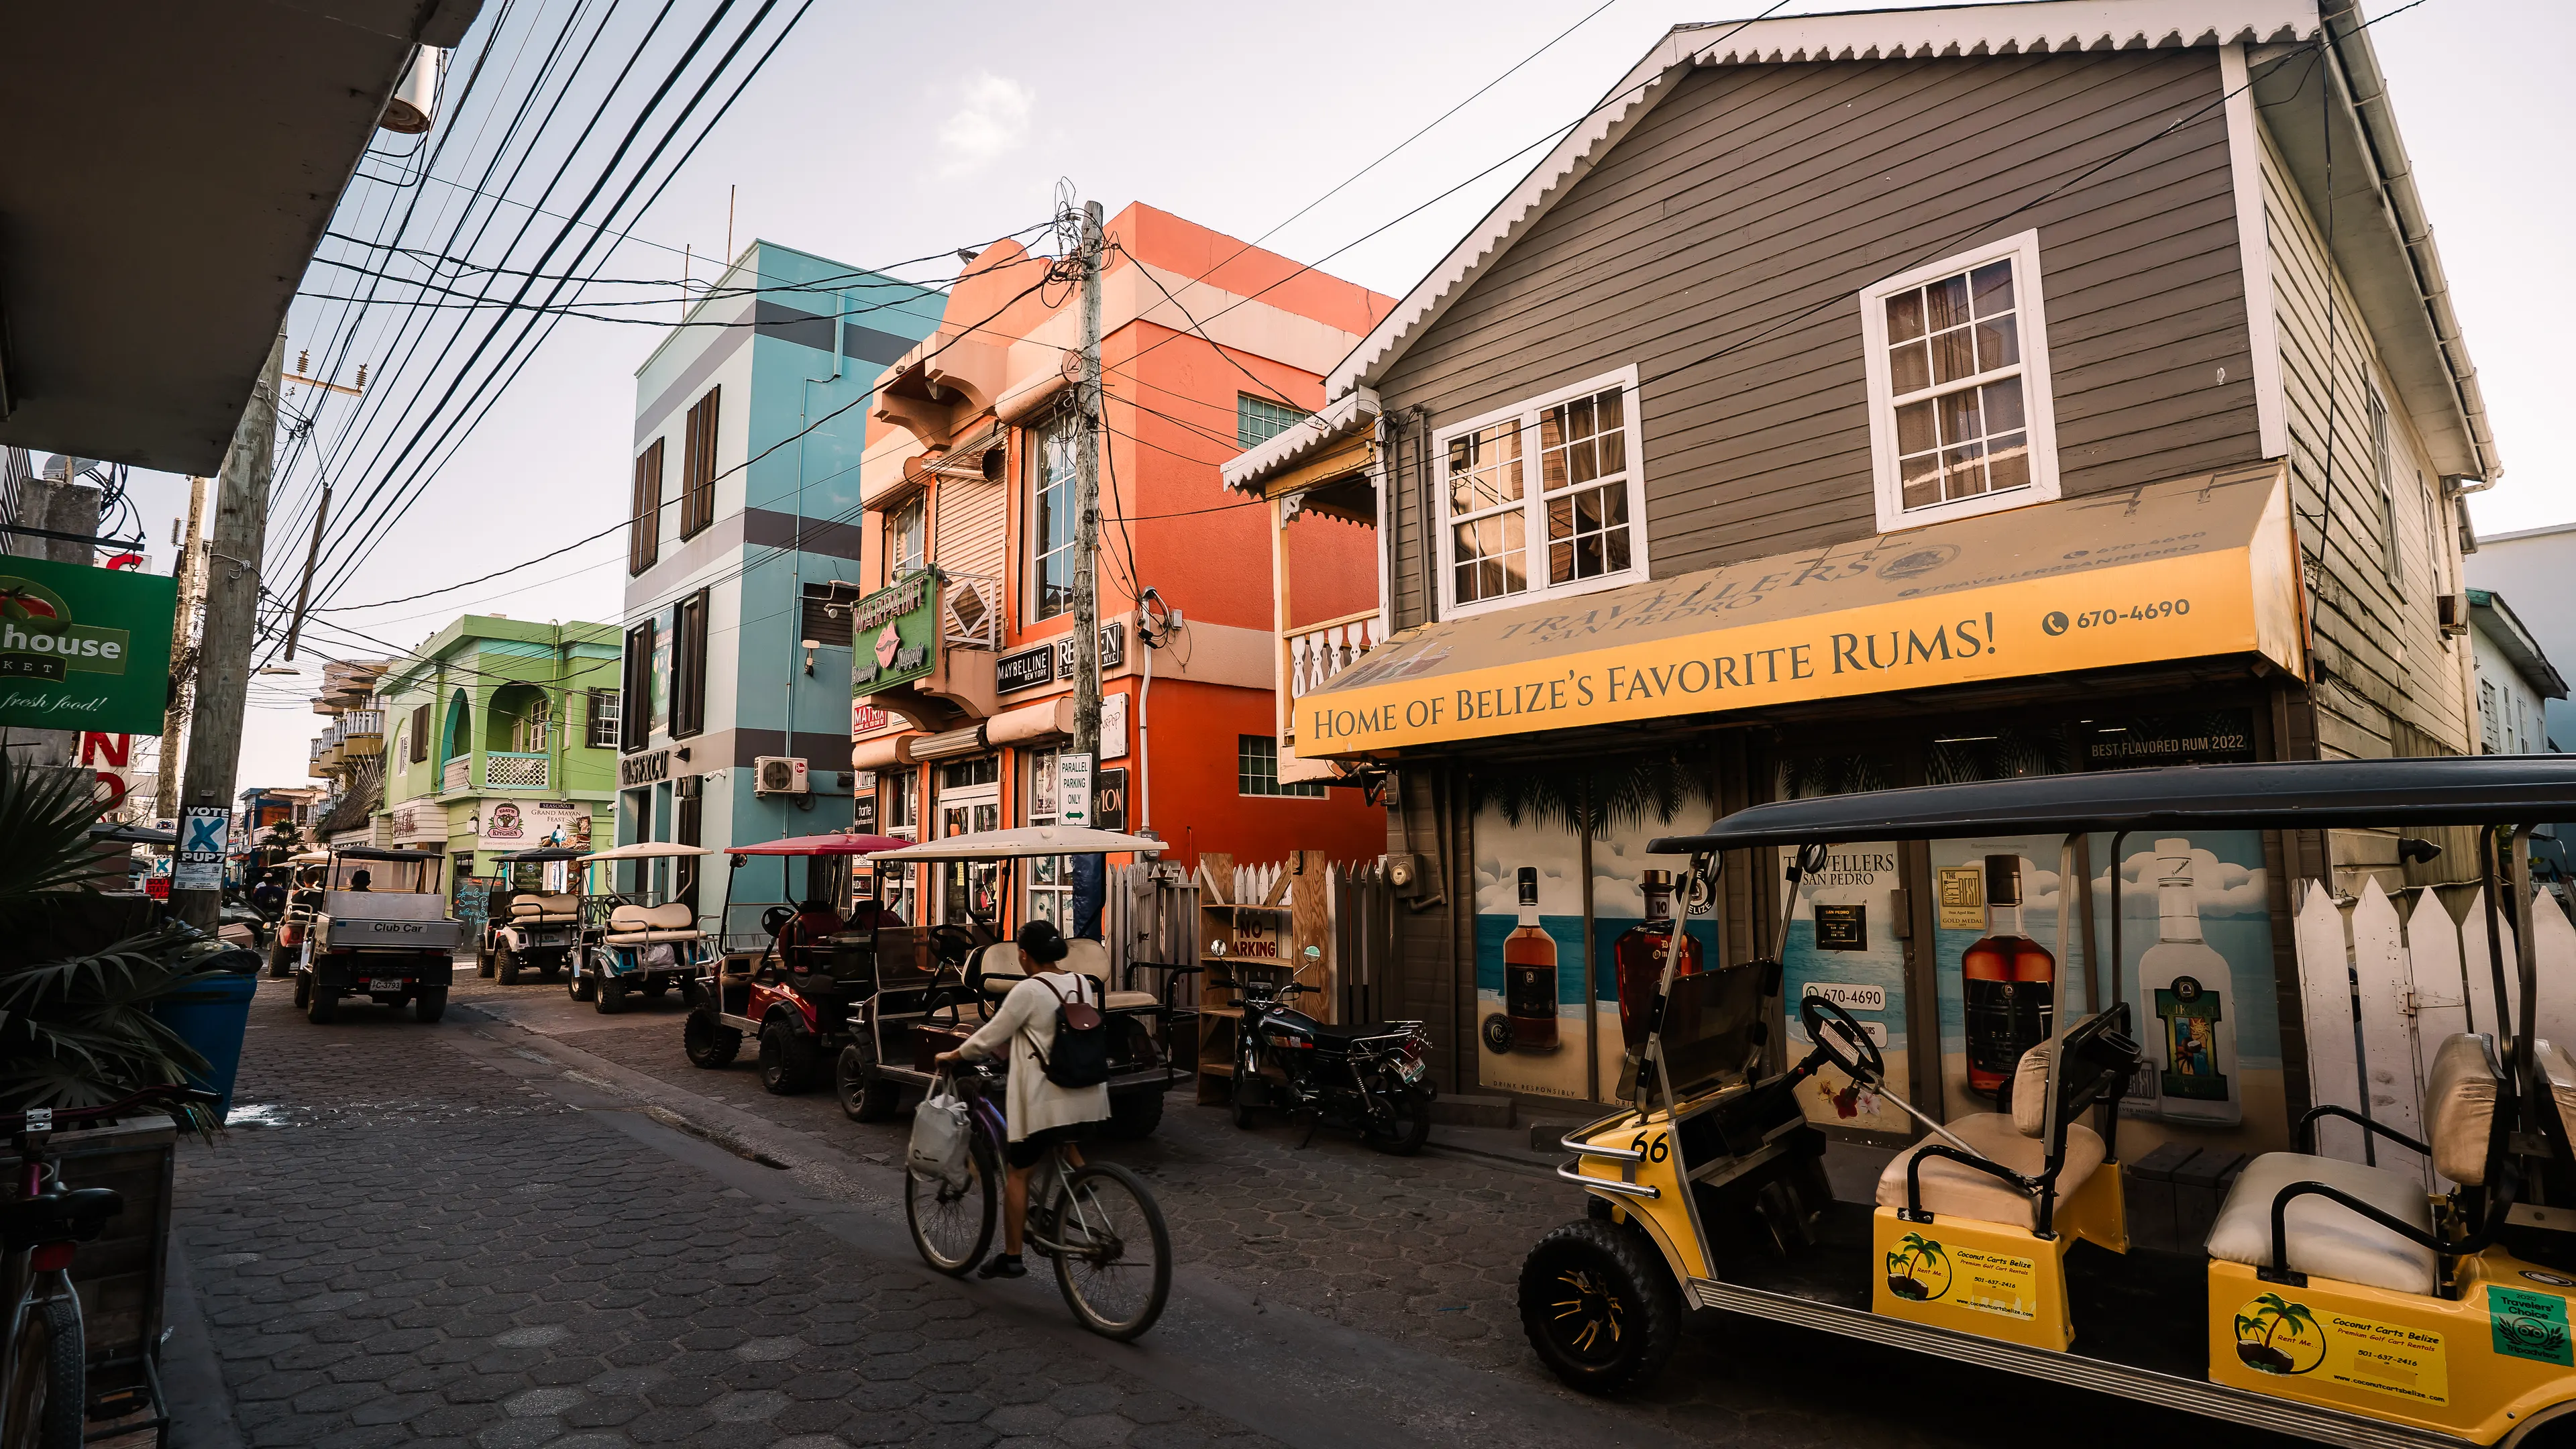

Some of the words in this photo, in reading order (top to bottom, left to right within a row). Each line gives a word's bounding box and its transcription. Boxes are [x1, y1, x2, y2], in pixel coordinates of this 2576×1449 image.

[2096, 531, 2207, 554] 670-4690
[854, 576, 924, 634] WARPAINT
[1495, 555, 1879, 640] TRAVELLERS
[1529, 623, 1607, 646] SAN
[1611, 595, 1763, 630] PEDRO
[2077, 598, 2190, 629] 670-4690
[851, 661, 877, 686] Beauty
[895, 641, 924, 672] Supply
[1104, 652, 1116, 663] NYC
[998, 653, 1046, 681] MAYBELLINE
[1024, 672, 1034, 681] NEW
[1034, 668, 1046, 679] YORK
[1313, 704, 1397, 740] HOME
[1405, 696, 1444, 728] OF
[1456, 669, 1594, 722] BELIZE'S
[1607, 644, 1814, 703] FAVORITE
[1830, 611, 1996, 676] RUMS!
[0, 692, 48, 709] fresh
[42, 695, 108, 713] food!
[2092, 744, 2118, 757] BEST
[2123, 739, 2178, 755] FLAVORED
[2182, 737, 2208, 751] RUM
[2212, 735, 2244, 749] 2022
[1062, 762, 1087, 772] PARALLEL
[675, 775, 696, 797] ATM
[1063, 778, 1085, 789] PARKING
[1067, 794, 1081, 804] ONLY
[187, 807, 229, 817] VOTE
[859, 804, 871, 816] tarte
[1783, 853, 1894, 873] TVELLERS
[1803, 874, 1826, 885] SAN
[1831, 873, 1874, 885] PEDRO
[1958, 877, 1978, 906] BEST
[1656, 901, 1667, 914] 10
[1688, 901, 1711, 914] ELIZE
[374, 923, 400, 932] Club
[403, 924, 423, 932] Car
[1240, 920, 1263, 938] NO
[1233, 941, 1276, 957] ARKING
[1823, 989, 1880, 1005] 670-4690
[1493, 1081, 1517, 1089] DRINK
[1521, 1084, 1575, 1097] RESPONSIBLY
[1631, 1130, 1668, 1163] 66
[1957, 1251, 1984, 1261] Coconut
[1987, 1255, 2006, 1265] Carts
[2010, 1259, 2031, 1269] Belize
[1960, 1259, 1982, 1268] Premium
[2008, 1268, 2029, 1276] Rentals
[1917, 1267, 1931, 1275] Rent
[1974, 1276, 2016, 1289] 501-637-2416
[1956, 1299, 2034, 1318] www.coconutcartsbelize.com
[2332, 1317, 2372, 1332] Coconut
[2375, 1324, 2404, 1338] Carts
[2408, 1330, 2440, 1345] Belize
[2277, 1334, 2296, 1346] Rent
[2337, 1328, 2367, 1340] Premium
[2369, 1333, 2385, 1344] Golf
[2388, 1338, 2405, 1347] Cart
[2408, 1341, 2436, 1353] Rentals
[2358, 1349, 2418, 1366] 501-637-2416
[2506, 1344, 2561, 1360] Tripadvisor
[2333, 1373, 2445, 1403] www.coconutcartsbelize.com
